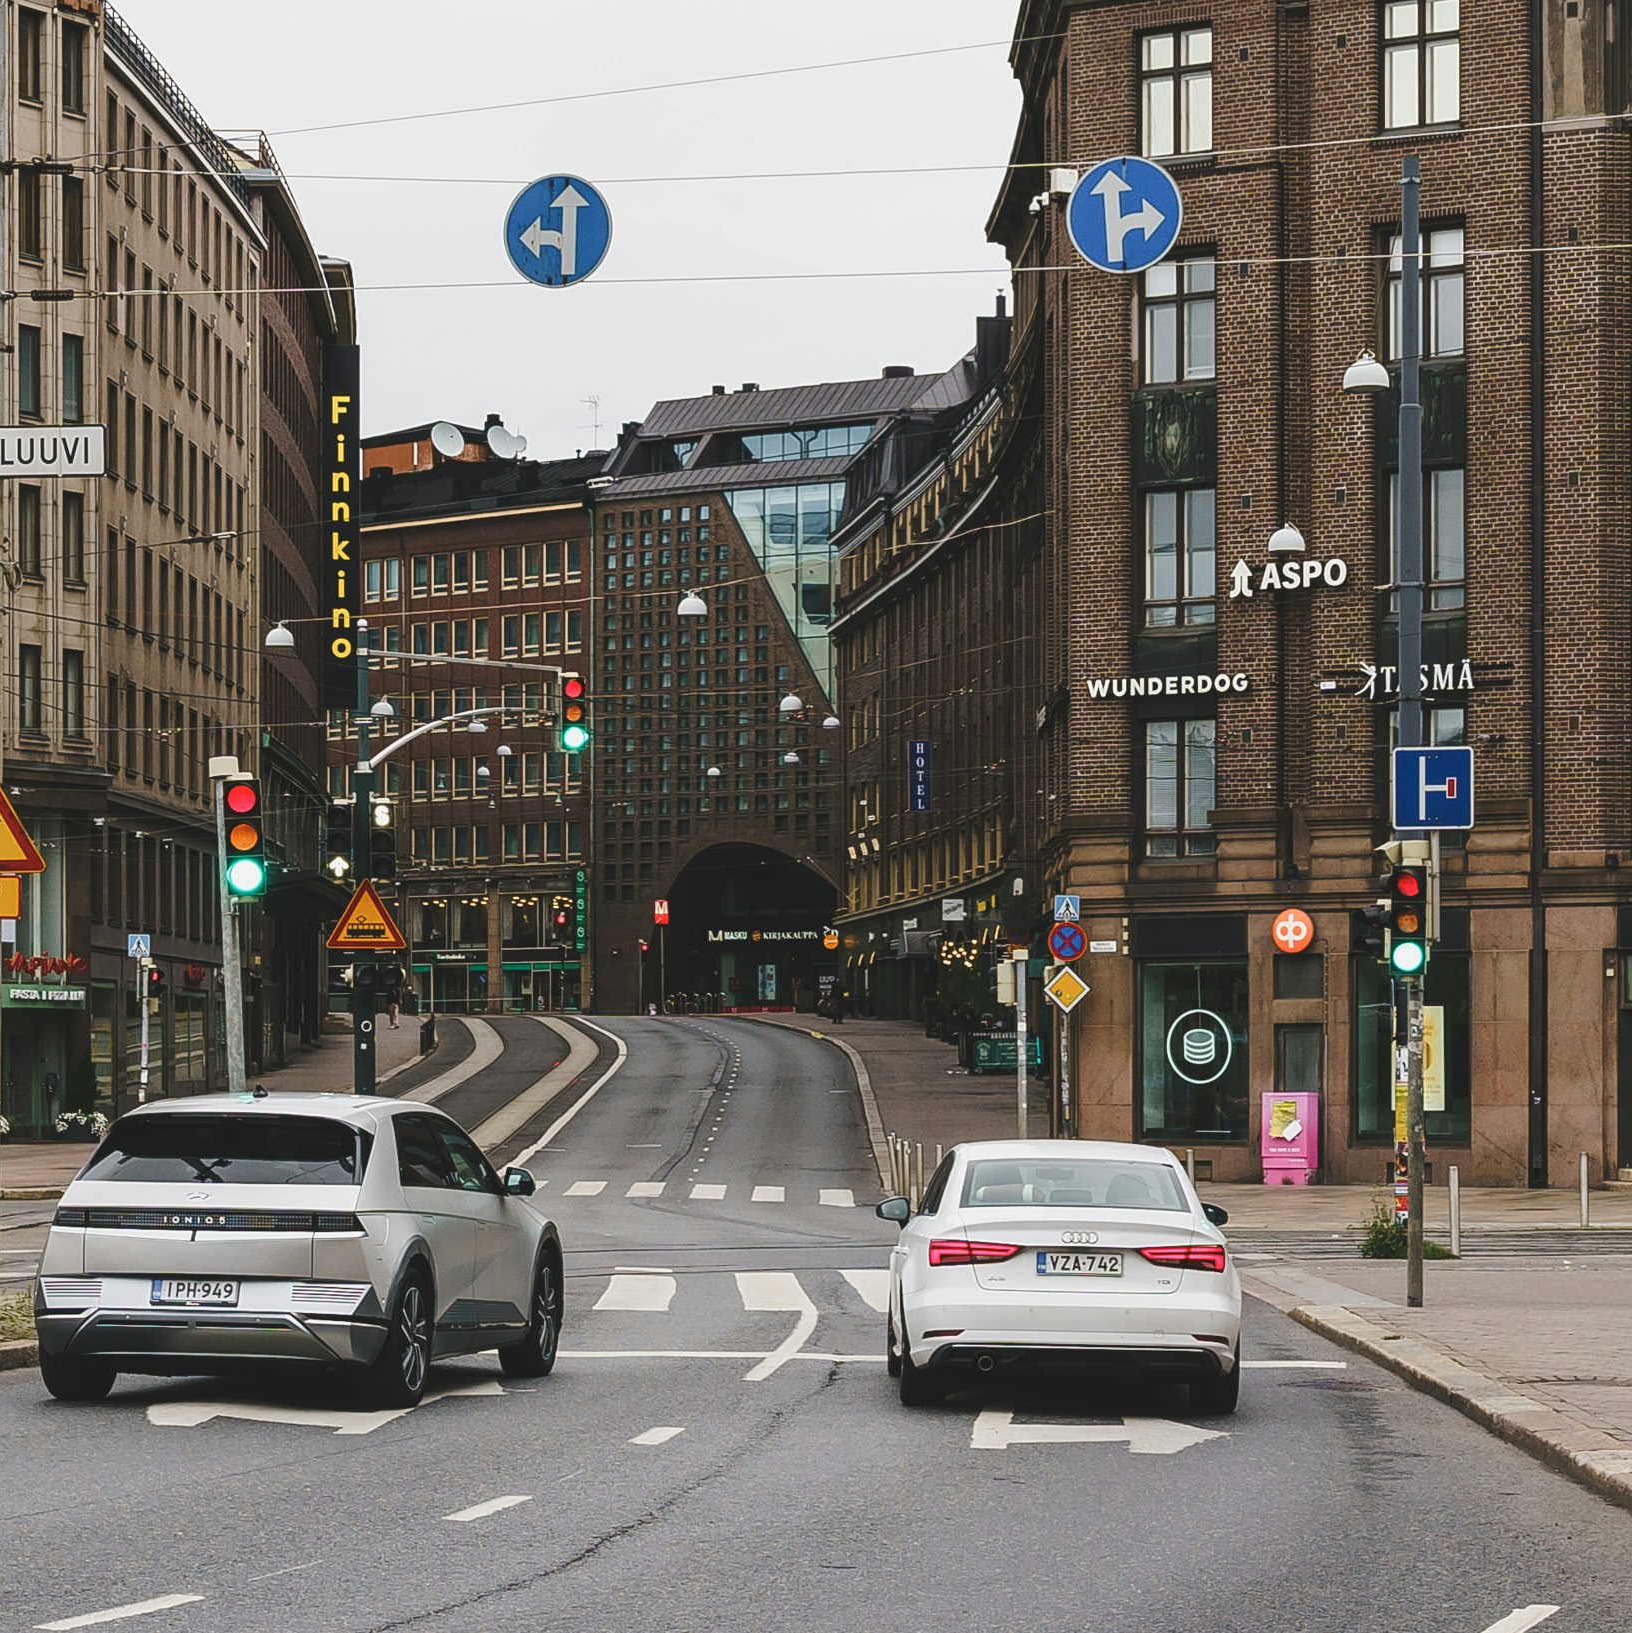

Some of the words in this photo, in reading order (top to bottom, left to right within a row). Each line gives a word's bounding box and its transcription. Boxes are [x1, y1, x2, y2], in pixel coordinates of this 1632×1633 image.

[331, 396, 352, 659] Finnkino
[1259, 558, 1348, 590] ASPO
[1087, 672, 1249, 699] WUNDERDOG
[915, 742, 925, 810] HOTEL
[763, 931, 818, 941] KIRJAKAUPPA
[4, 951, 89, 978] VAPIANO
[9, 988, 40, 1000] PASTA
[1049, 1255, 1119, 1272] VZA-742
[167, 1281, 235, 1299] IPH-949
